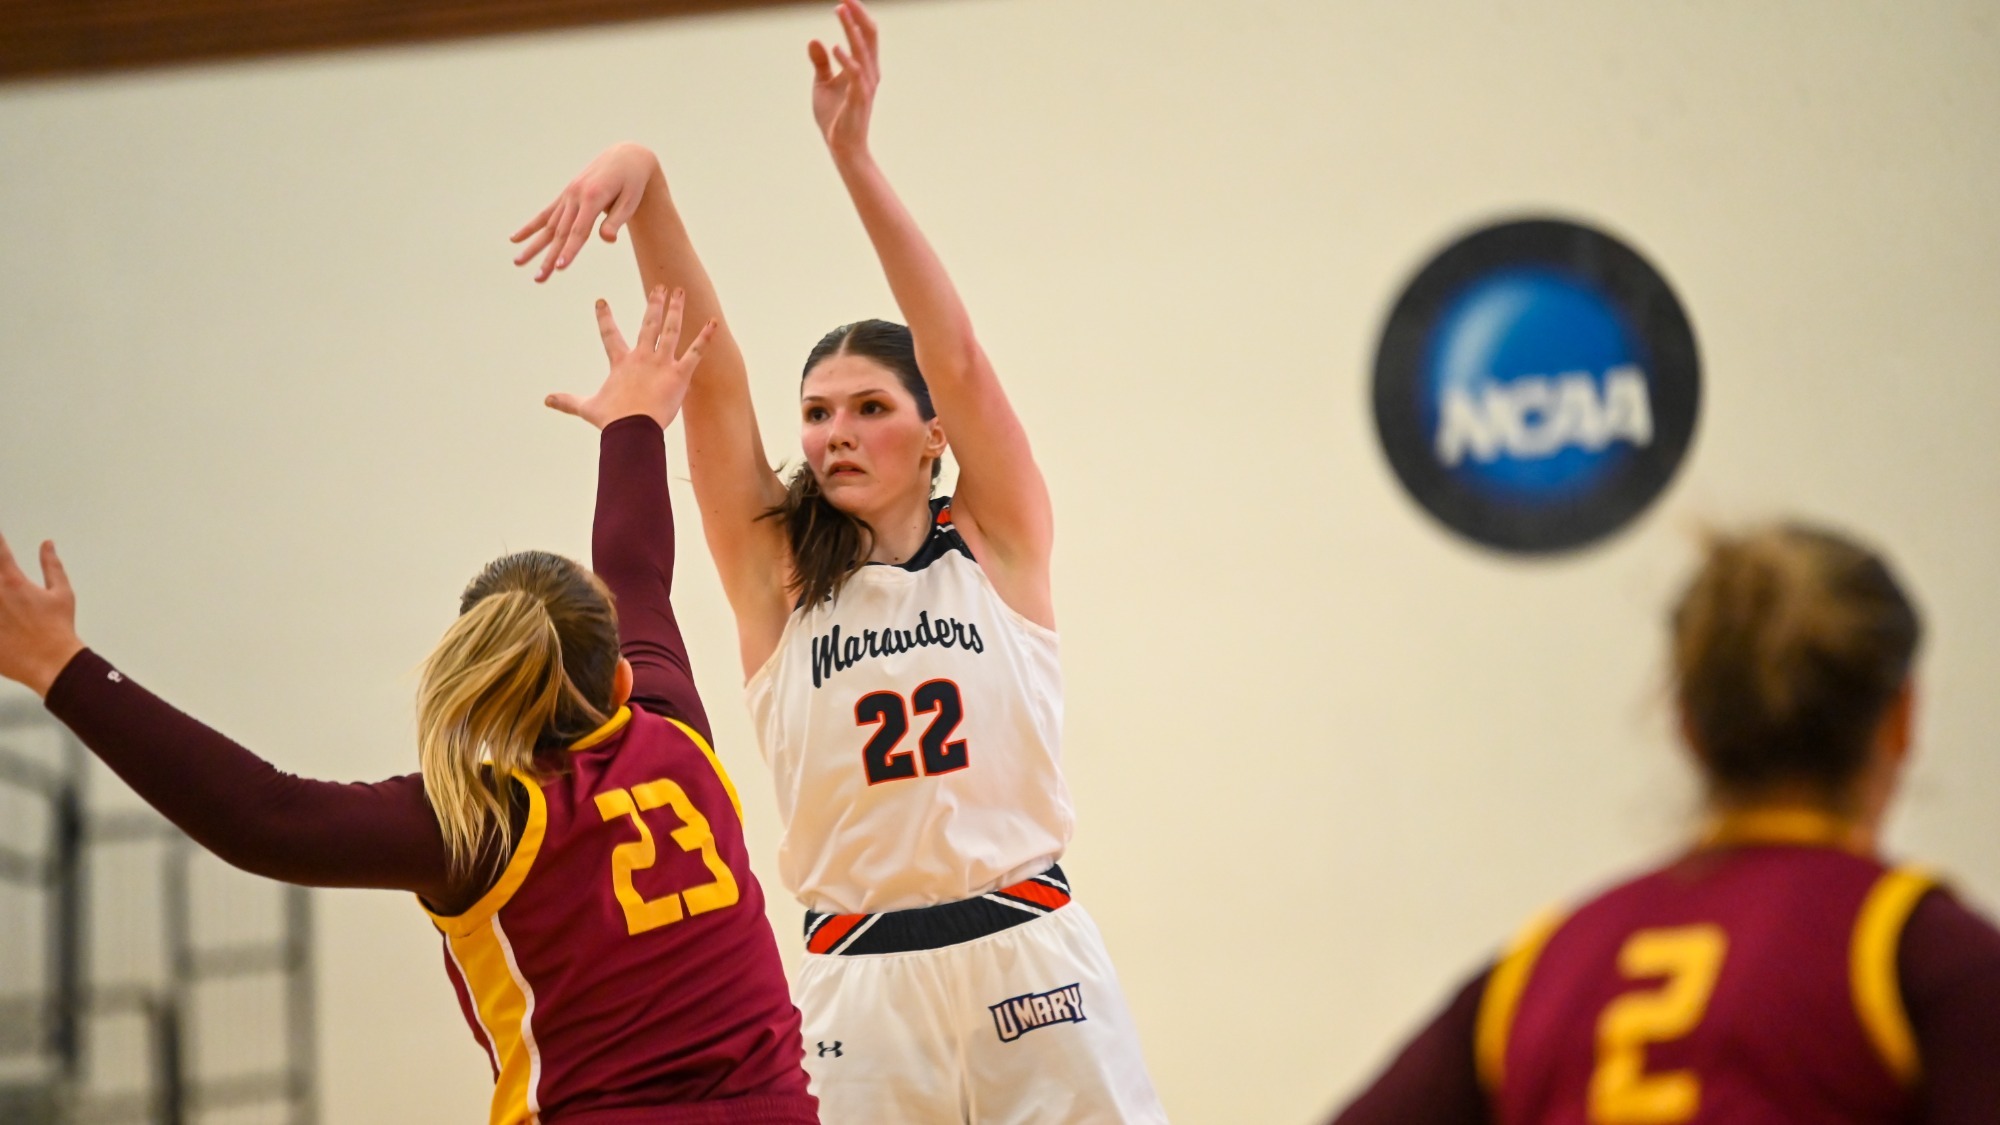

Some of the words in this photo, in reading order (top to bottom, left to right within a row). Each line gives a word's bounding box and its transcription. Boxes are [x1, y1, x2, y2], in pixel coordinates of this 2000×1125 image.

[1436, 364, 1654, 466] NCAA
[812, 610, 984, 689] Marauders
[854, 678, 969, 786] 22
[594, 778, 739, 936] 23
[988, 982, 1087, 1043] UMARY
[1587, 922, 1730, 1125] 2
